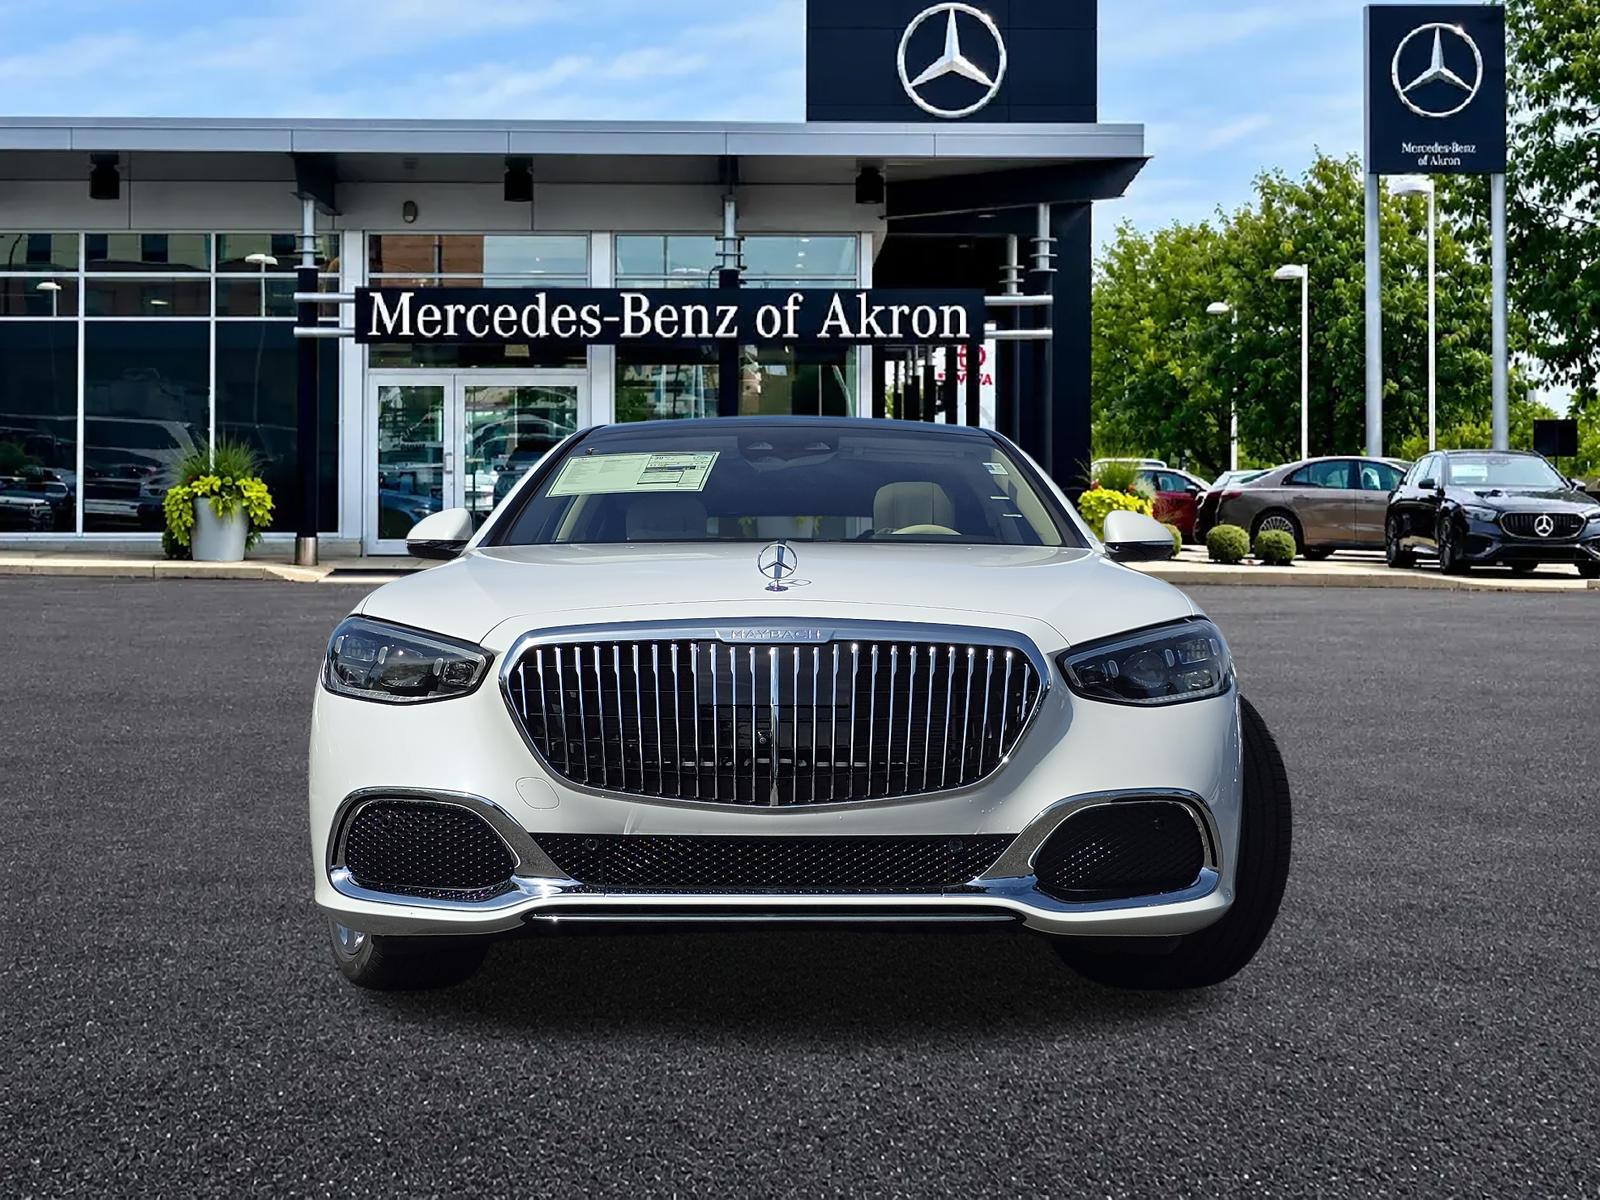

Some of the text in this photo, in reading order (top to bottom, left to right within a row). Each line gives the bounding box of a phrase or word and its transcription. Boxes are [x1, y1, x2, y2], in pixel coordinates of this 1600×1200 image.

[1401, 142, 1477, 154] Mercedes-Benz
[1417, 154, 1461, 166] of Akron
[367, 291, 971, 339] Mercedes-Benz of Akron
[730, 629, 821, 640] MAYBACH
